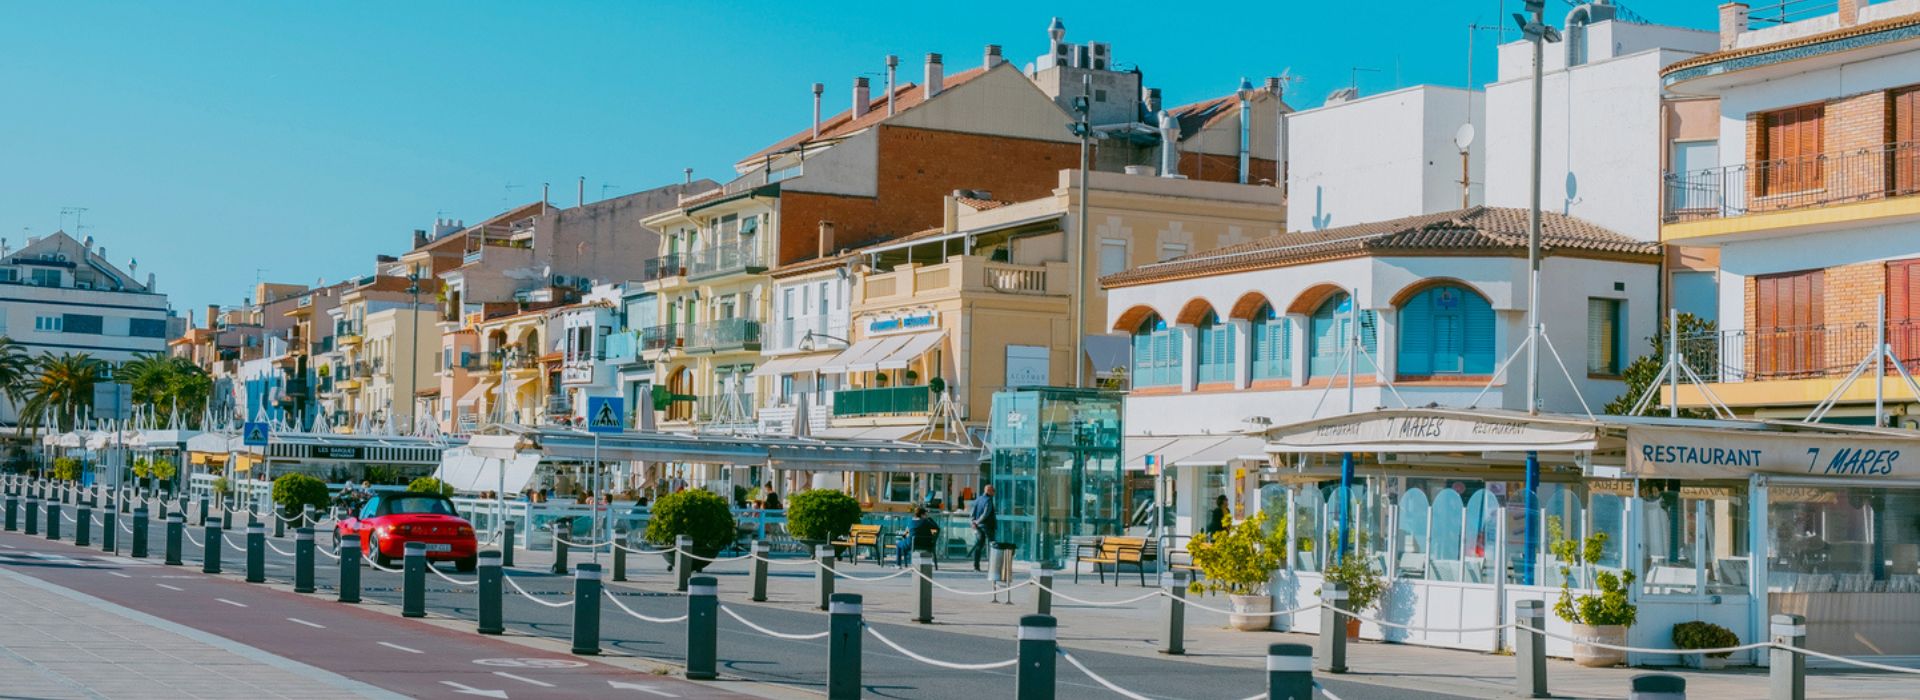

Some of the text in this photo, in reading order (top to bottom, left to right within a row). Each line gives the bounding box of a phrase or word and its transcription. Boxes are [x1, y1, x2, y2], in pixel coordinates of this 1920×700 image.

[1387, 416, 1394, 437] 7
[1399, 416, 1445, 438] MARES
[1472, 421, 1530, 435] RESTAURANT
[1642, 443, 1901, 475] RESTAURANT 7 MARES
